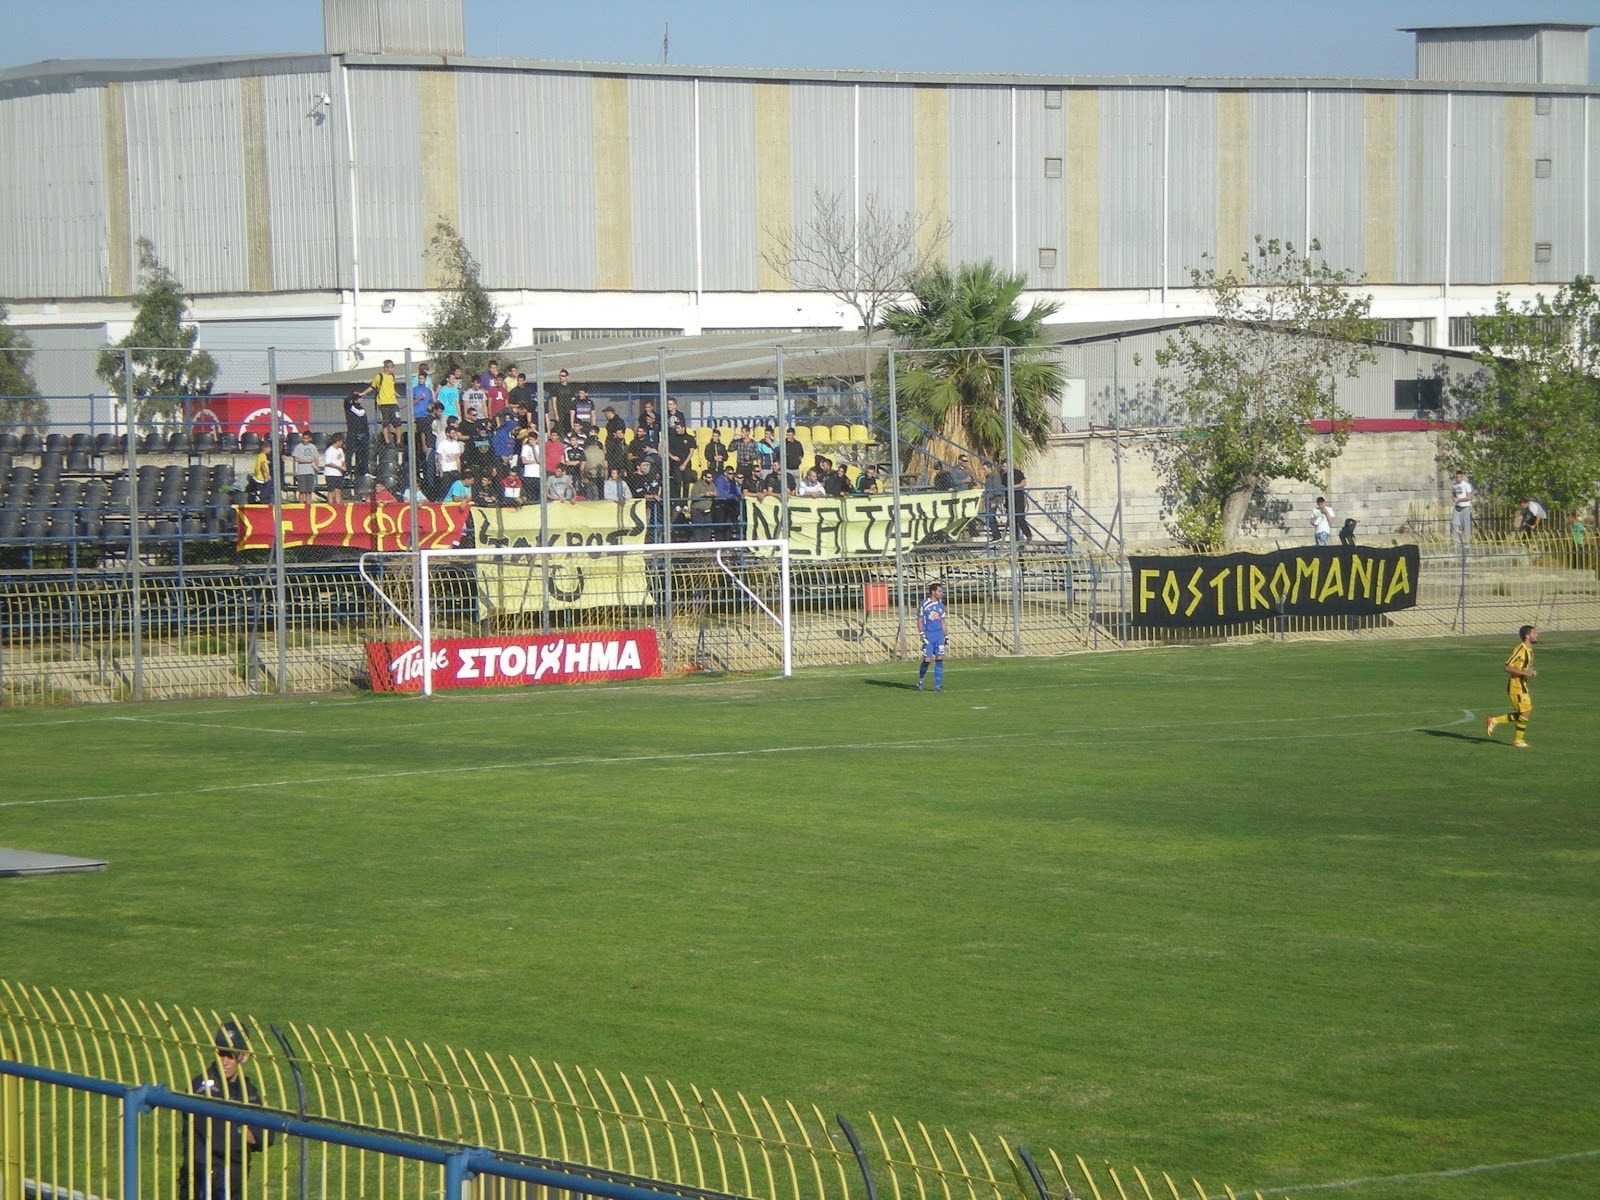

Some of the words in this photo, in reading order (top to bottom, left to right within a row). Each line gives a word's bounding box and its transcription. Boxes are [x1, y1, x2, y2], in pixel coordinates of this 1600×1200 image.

[231, 502, 475, 552] ΣΕΡΙΦΟΣ
[1139, 553, 1410, 617] FOSTIROMANIA
[456, 639, 642, 680] ΣΤΟΙΧΗΜΑ
